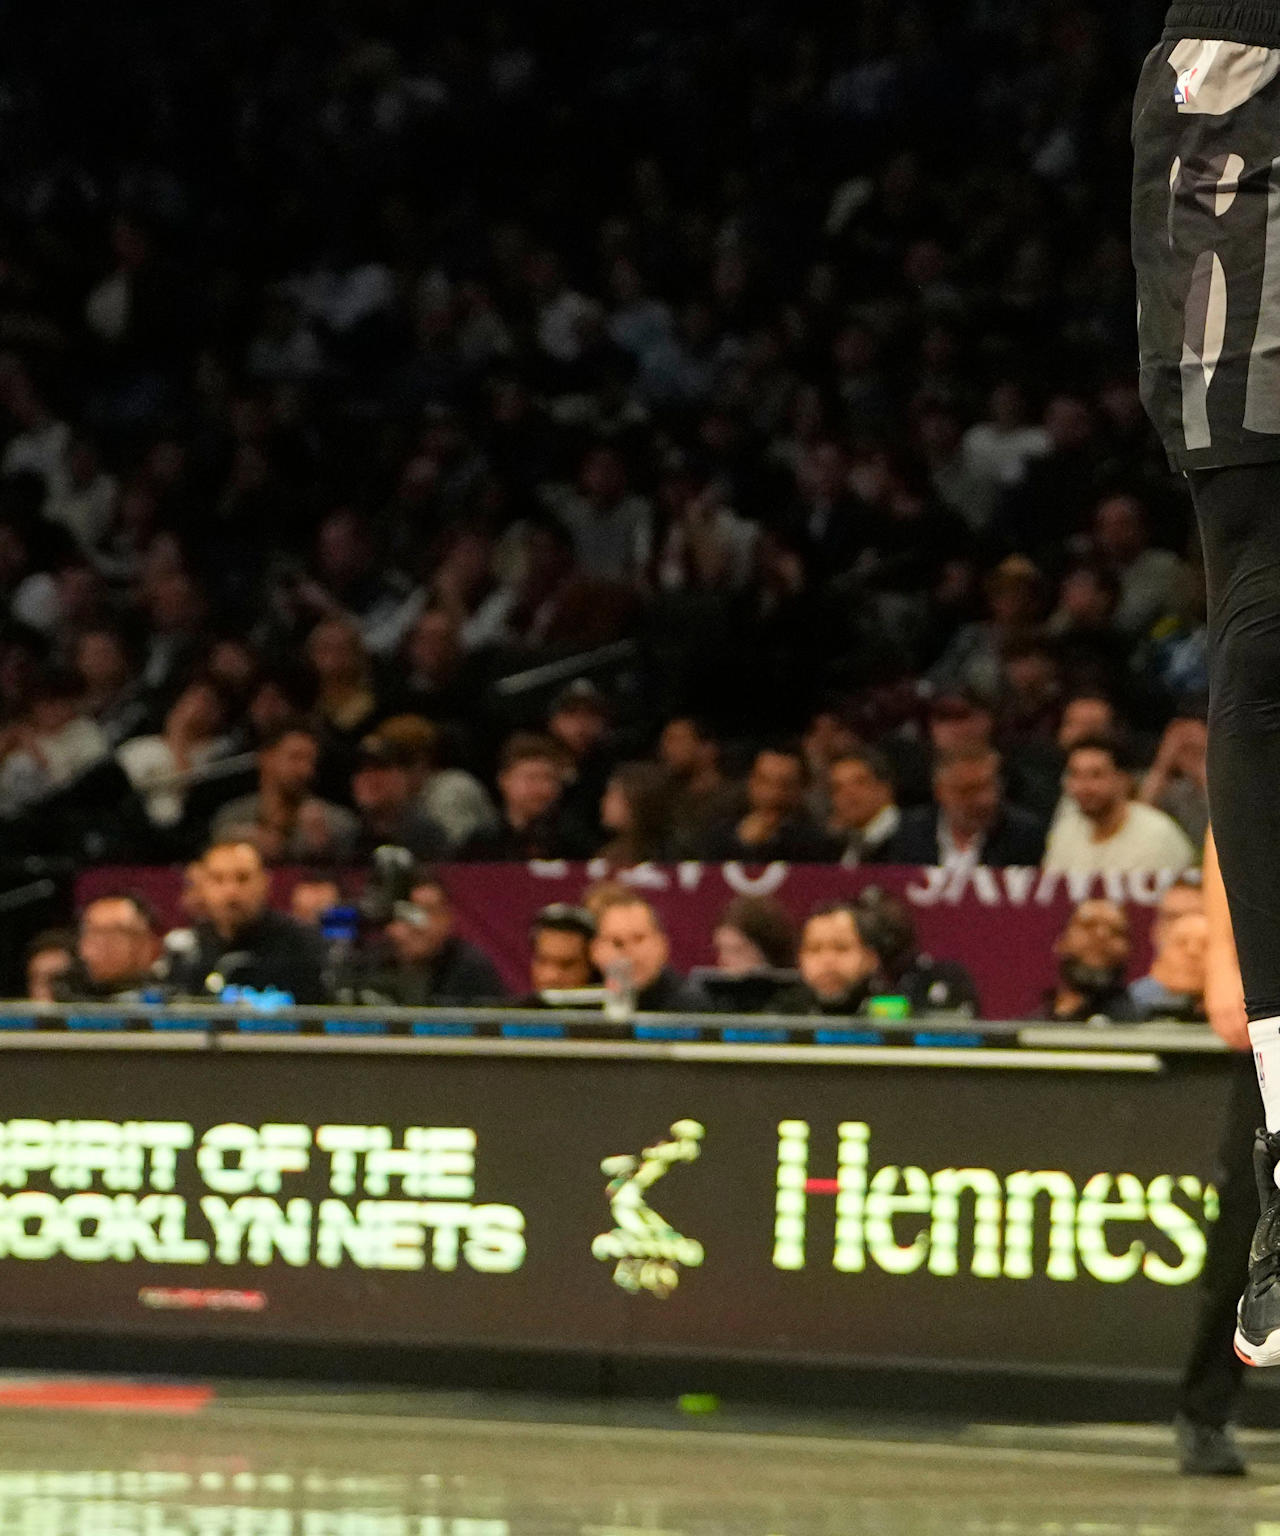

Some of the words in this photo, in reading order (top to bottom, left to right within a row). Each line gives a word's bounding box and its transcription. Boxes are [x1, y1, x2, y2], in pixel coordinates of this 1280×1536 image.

[0, 1119, 194, 1192] PIRIT
[199, 1123, 311, 1194] OF
[316, 1125, 477, 1199] THE
[0, 1191, 311, 1266] OOKLYN
[317, 1199, 527, 1274] NETS
[773, 1120, 1221, 1286] Hennes
